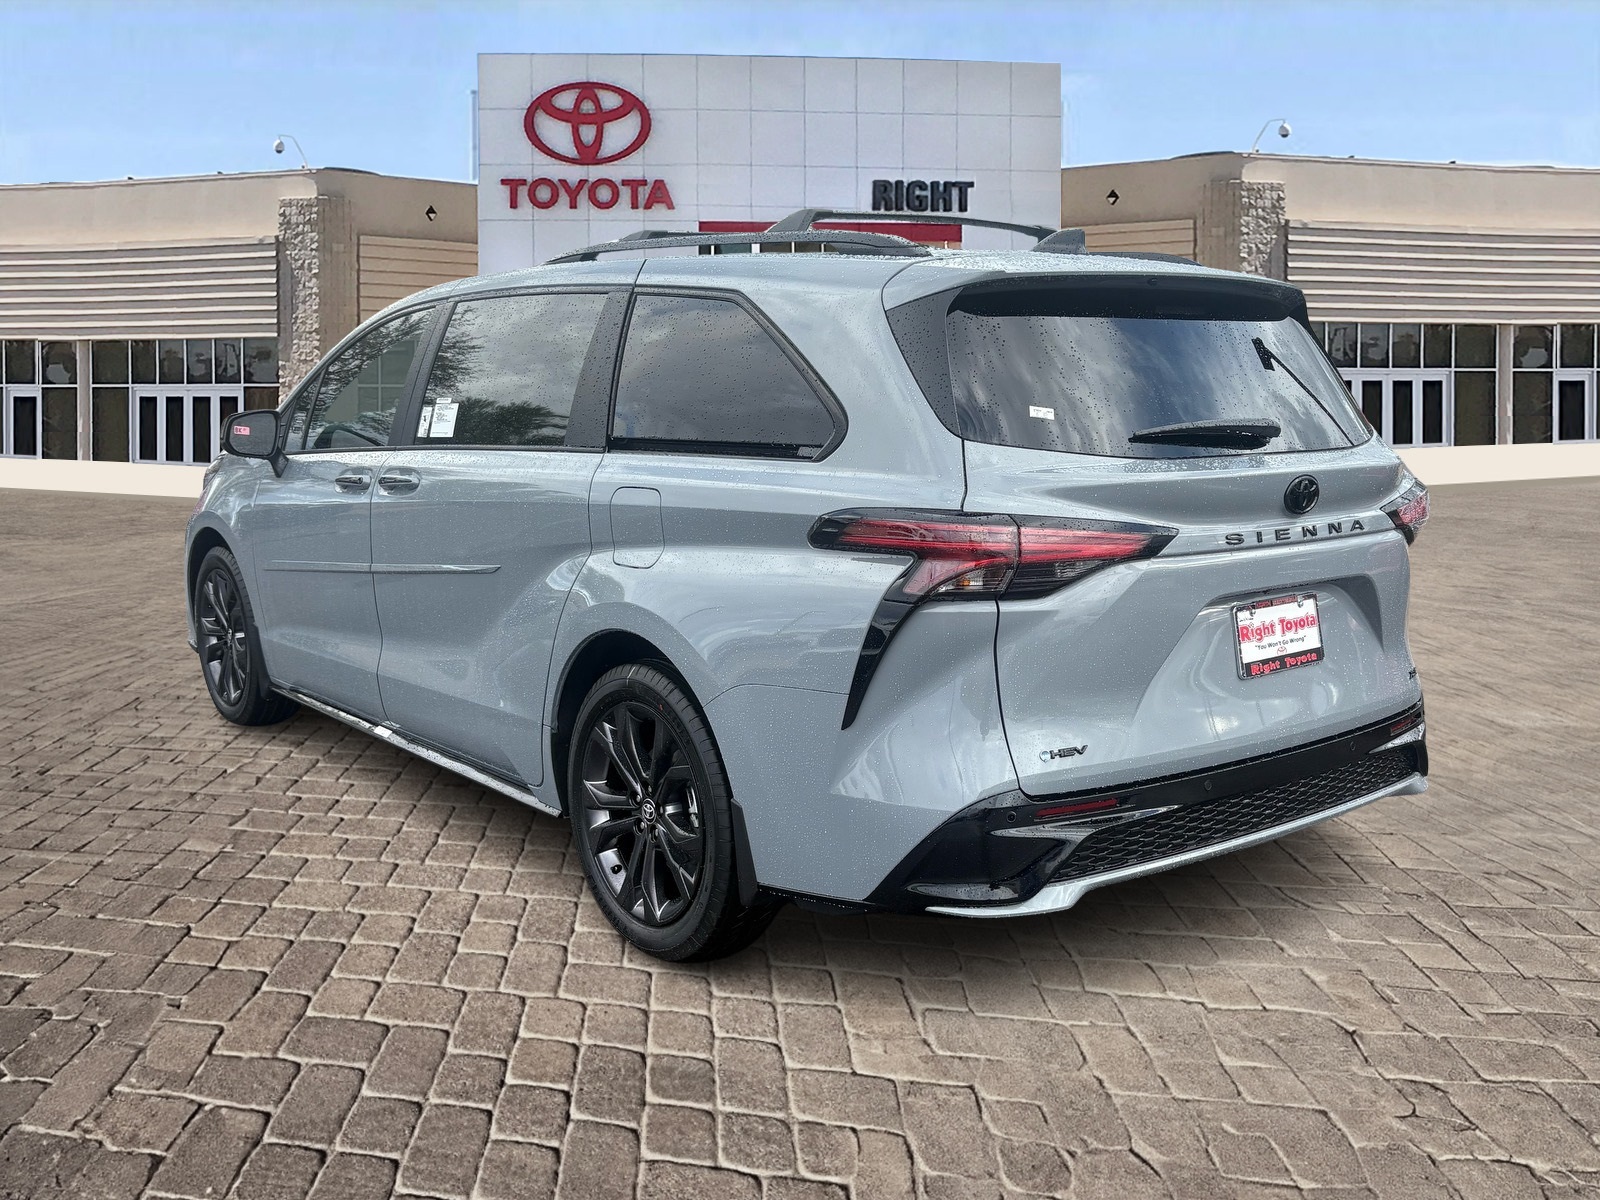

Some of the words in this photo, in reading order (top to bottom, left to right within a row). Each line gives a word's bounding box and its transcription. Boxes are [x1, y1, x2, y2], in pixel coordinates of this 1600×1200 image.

[500, 178, 675, 210] TOYOTA
[871, 179, 975, 213] RIGHT
[1225, 519, 1365, 546] SIENNA
[1239, 621, 1276, 642] Right
[1279, 613, 1317, 636] Toyota
[1250, 660, 1281, 675] Right
[1284, 651, 1318, 668] Toyota
[1049, 744, 1088, 759] HEV
